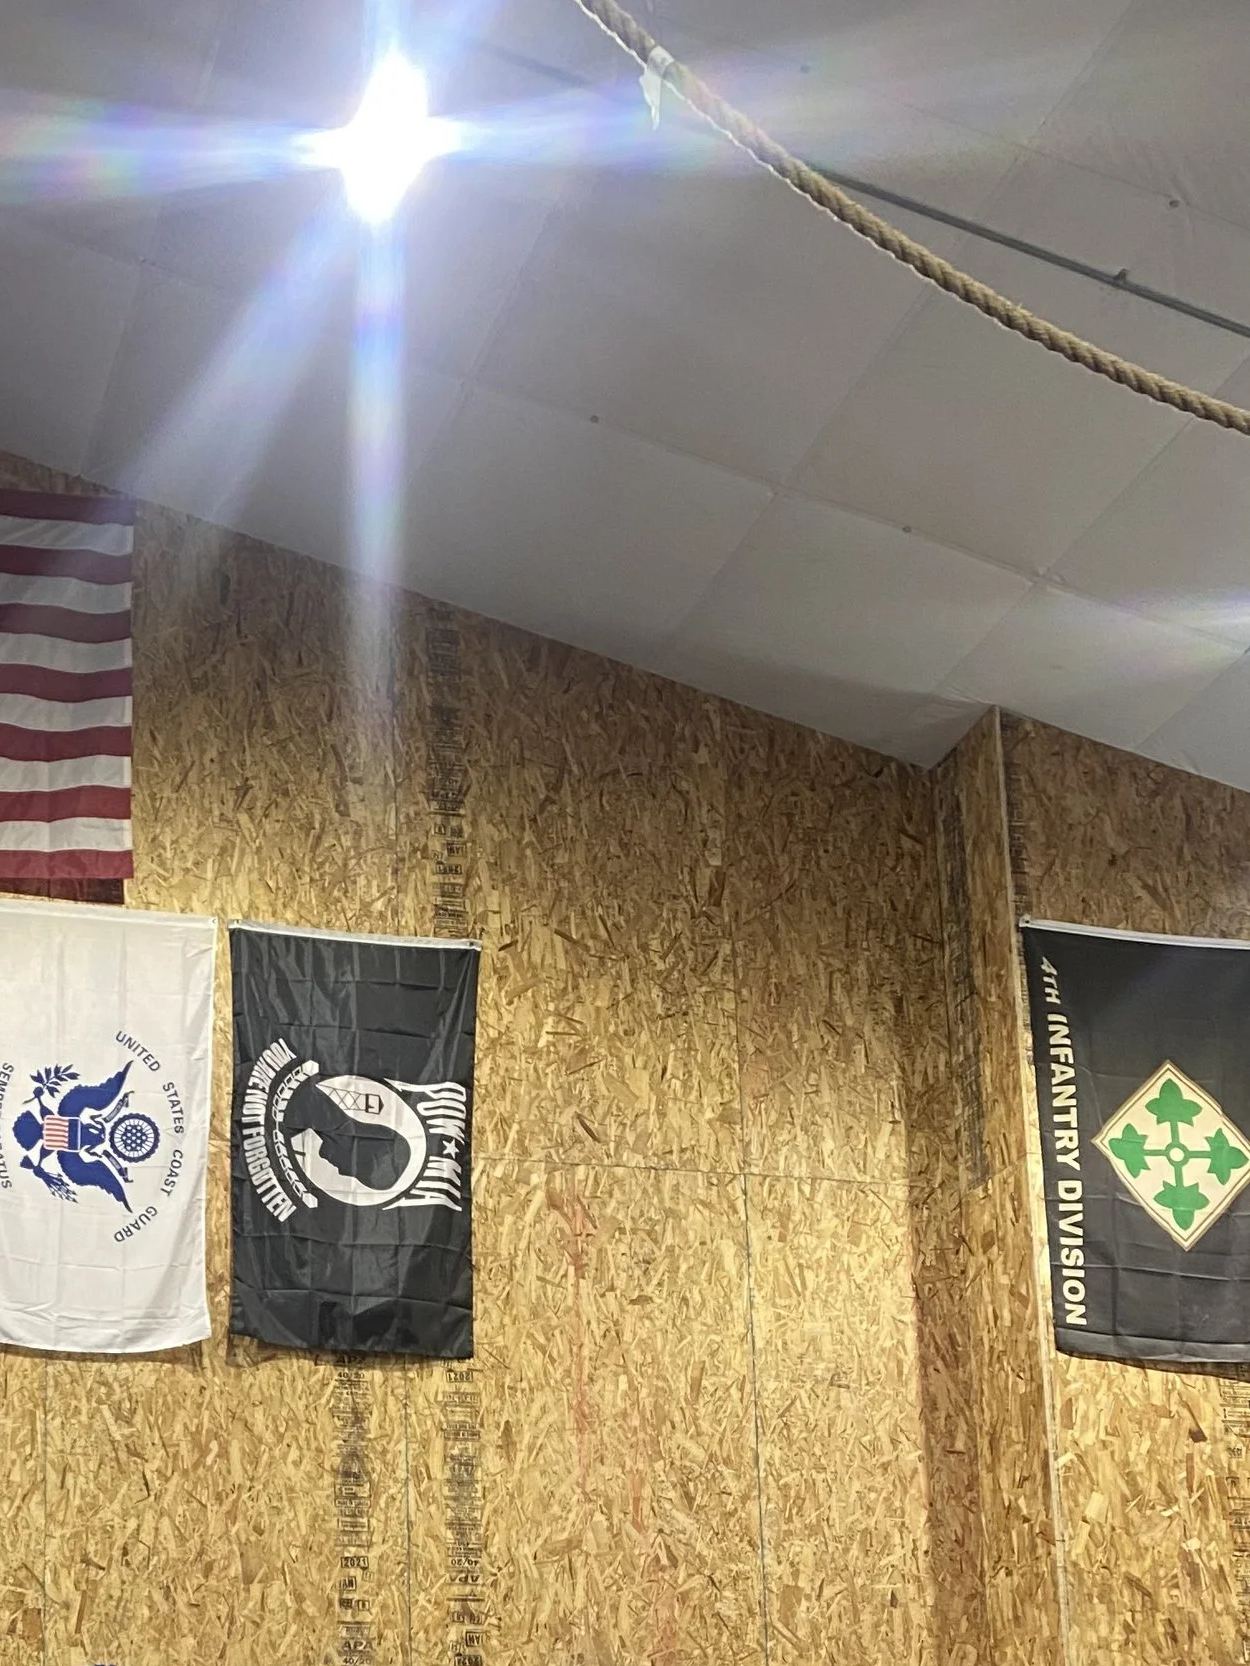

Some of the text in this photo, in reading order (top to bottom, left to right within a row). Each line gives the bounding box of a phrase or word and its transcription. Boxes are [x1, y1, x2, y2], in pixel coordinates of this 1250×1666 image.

[113, 1030, 185, 1242] UNITED STATES COAST GUARD
[241, 1038, 297, 1222] YOU ARE NOT FORGOTTEN
[382, 1077, 467, 1212] POW MIA
[1040, 956, 1088, 1327] 4TH INFANTRY DIVISION
